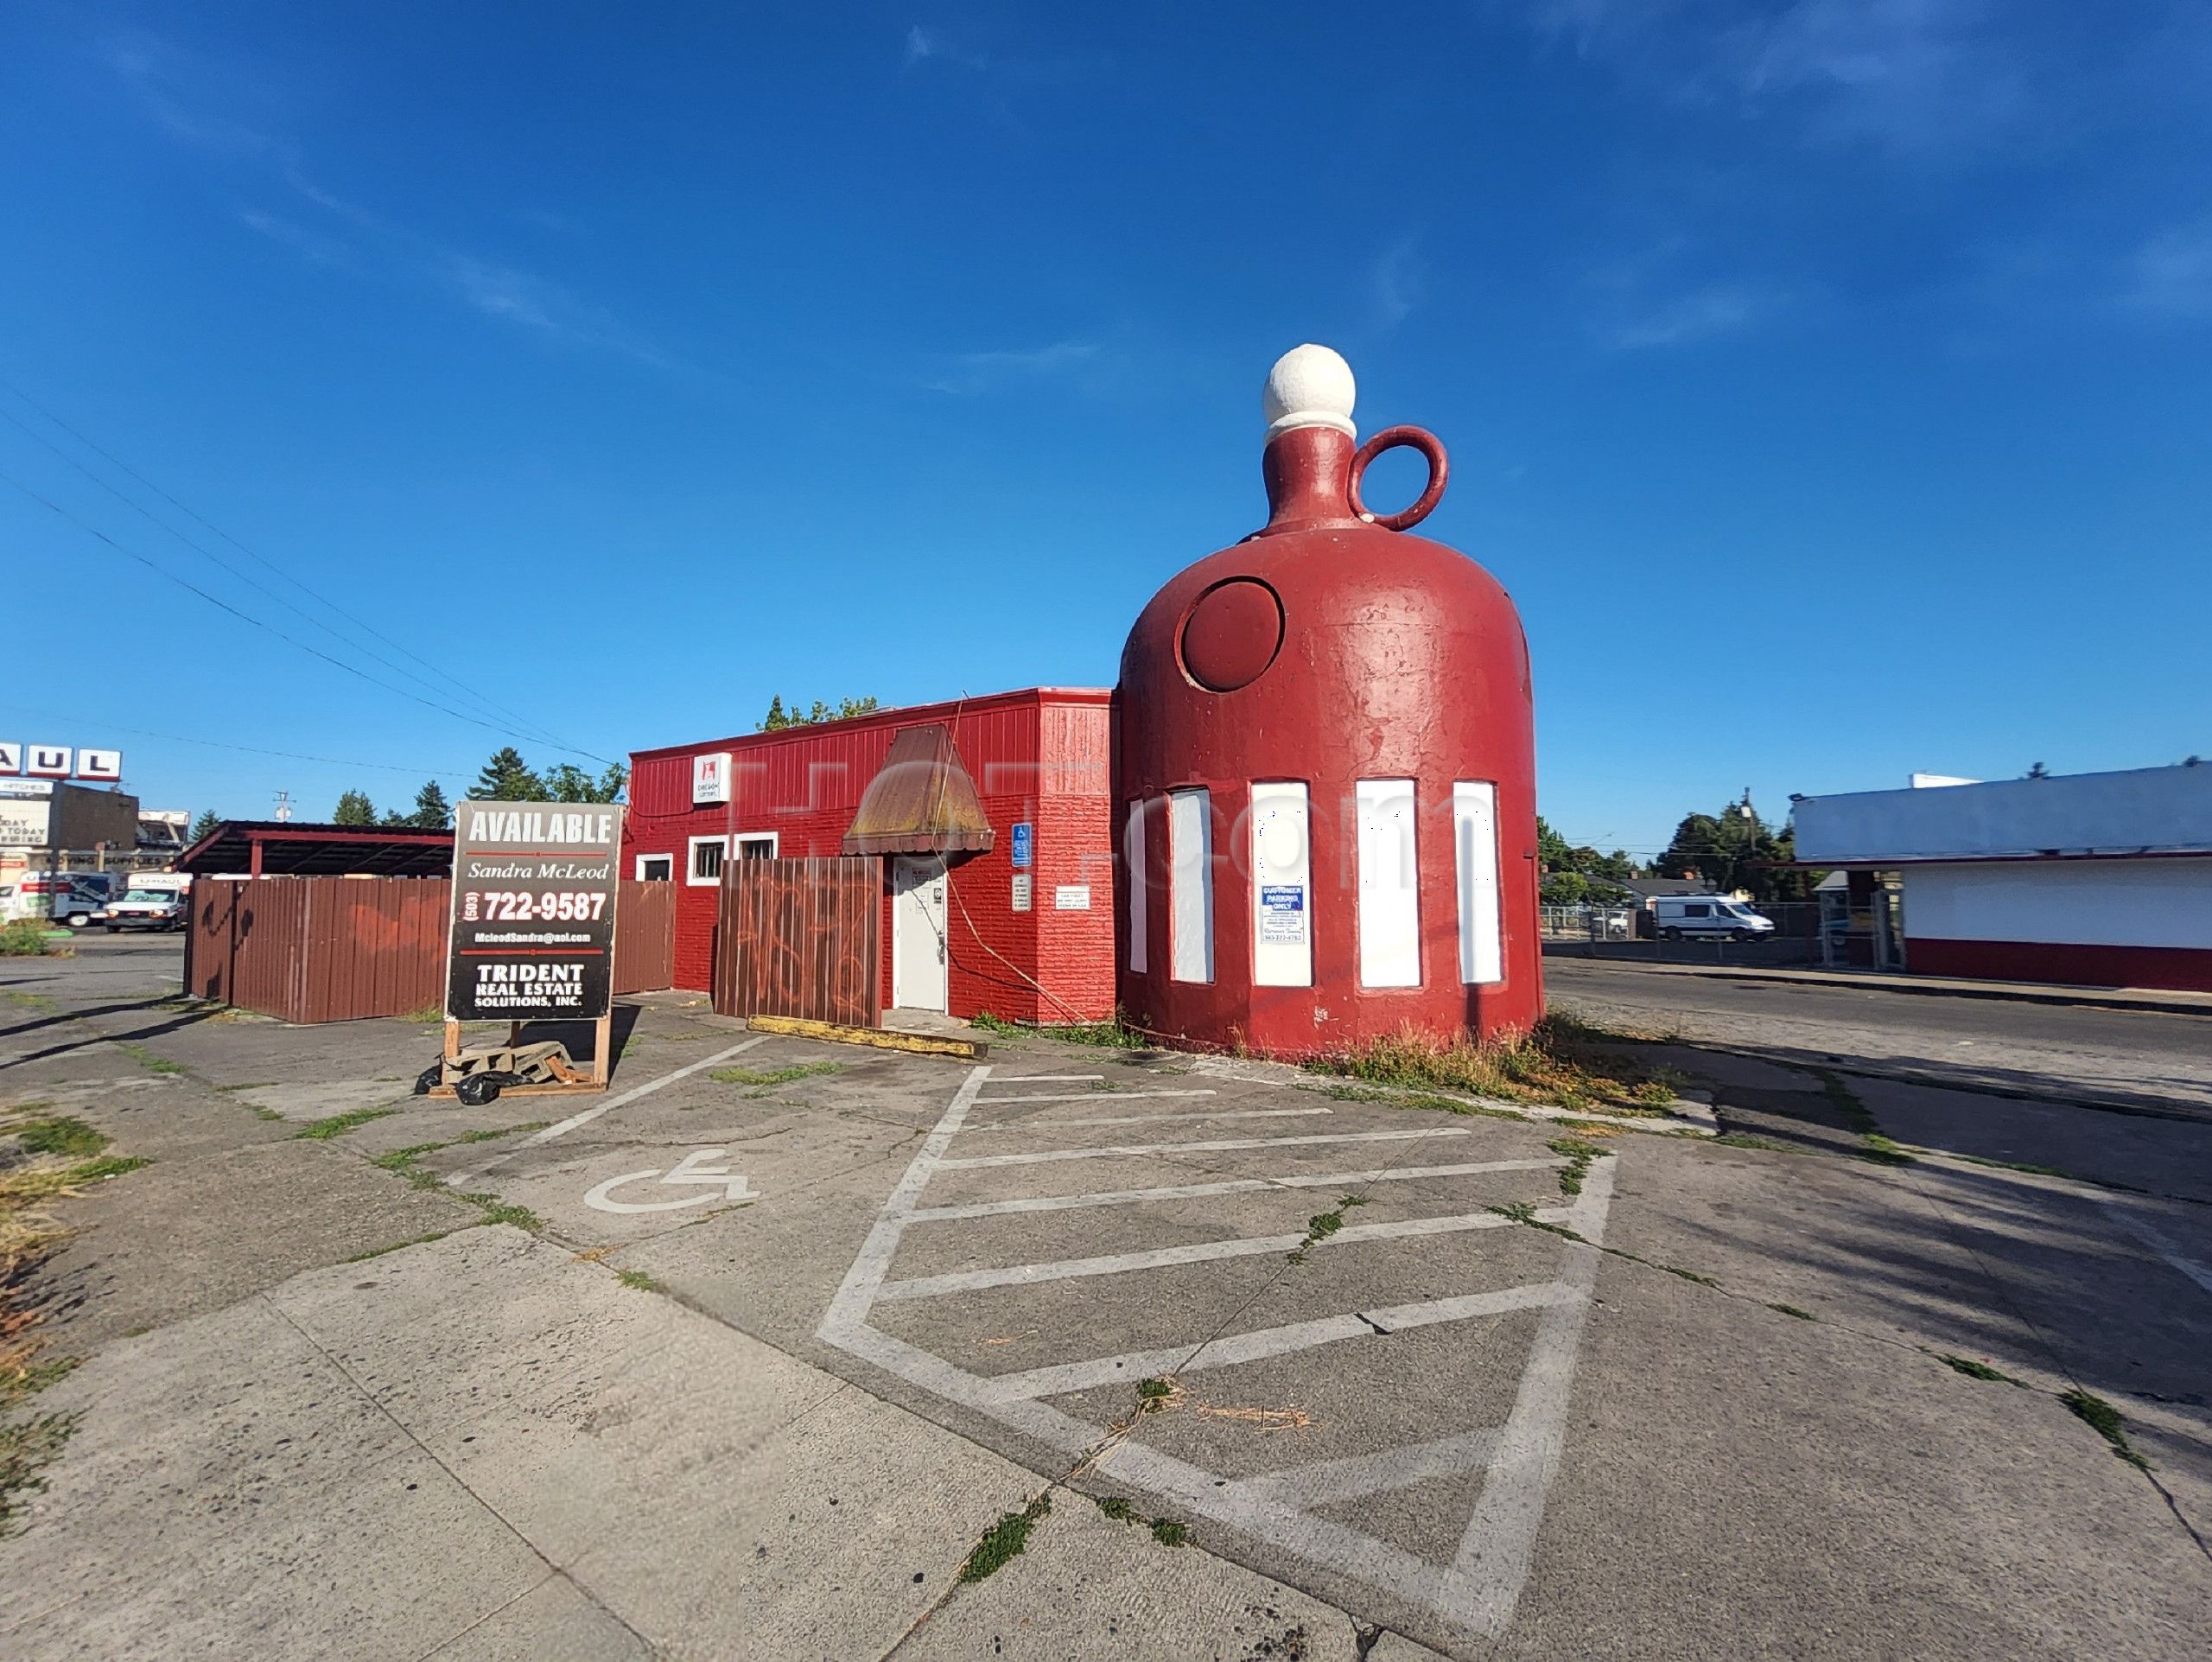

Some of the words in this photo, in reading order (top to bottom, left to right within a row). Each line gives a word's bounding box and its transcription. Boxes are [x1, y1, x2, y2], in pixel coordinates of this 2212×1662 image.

[469, 811, 611, 844] AVAILABLE
[467, 863, 532, 879] Sandra
[537, 863, 609, 880] McLeod
[463, 891, 480, 921] (503)
[484, 892, 607, 921] 722-9587
[477, 964, 584, 982] TRIDENT
[475, 983, 518, 996] REAL
[524, 984, 583, 996] ESTATE
[556, 997, 582, 1007] INC.
